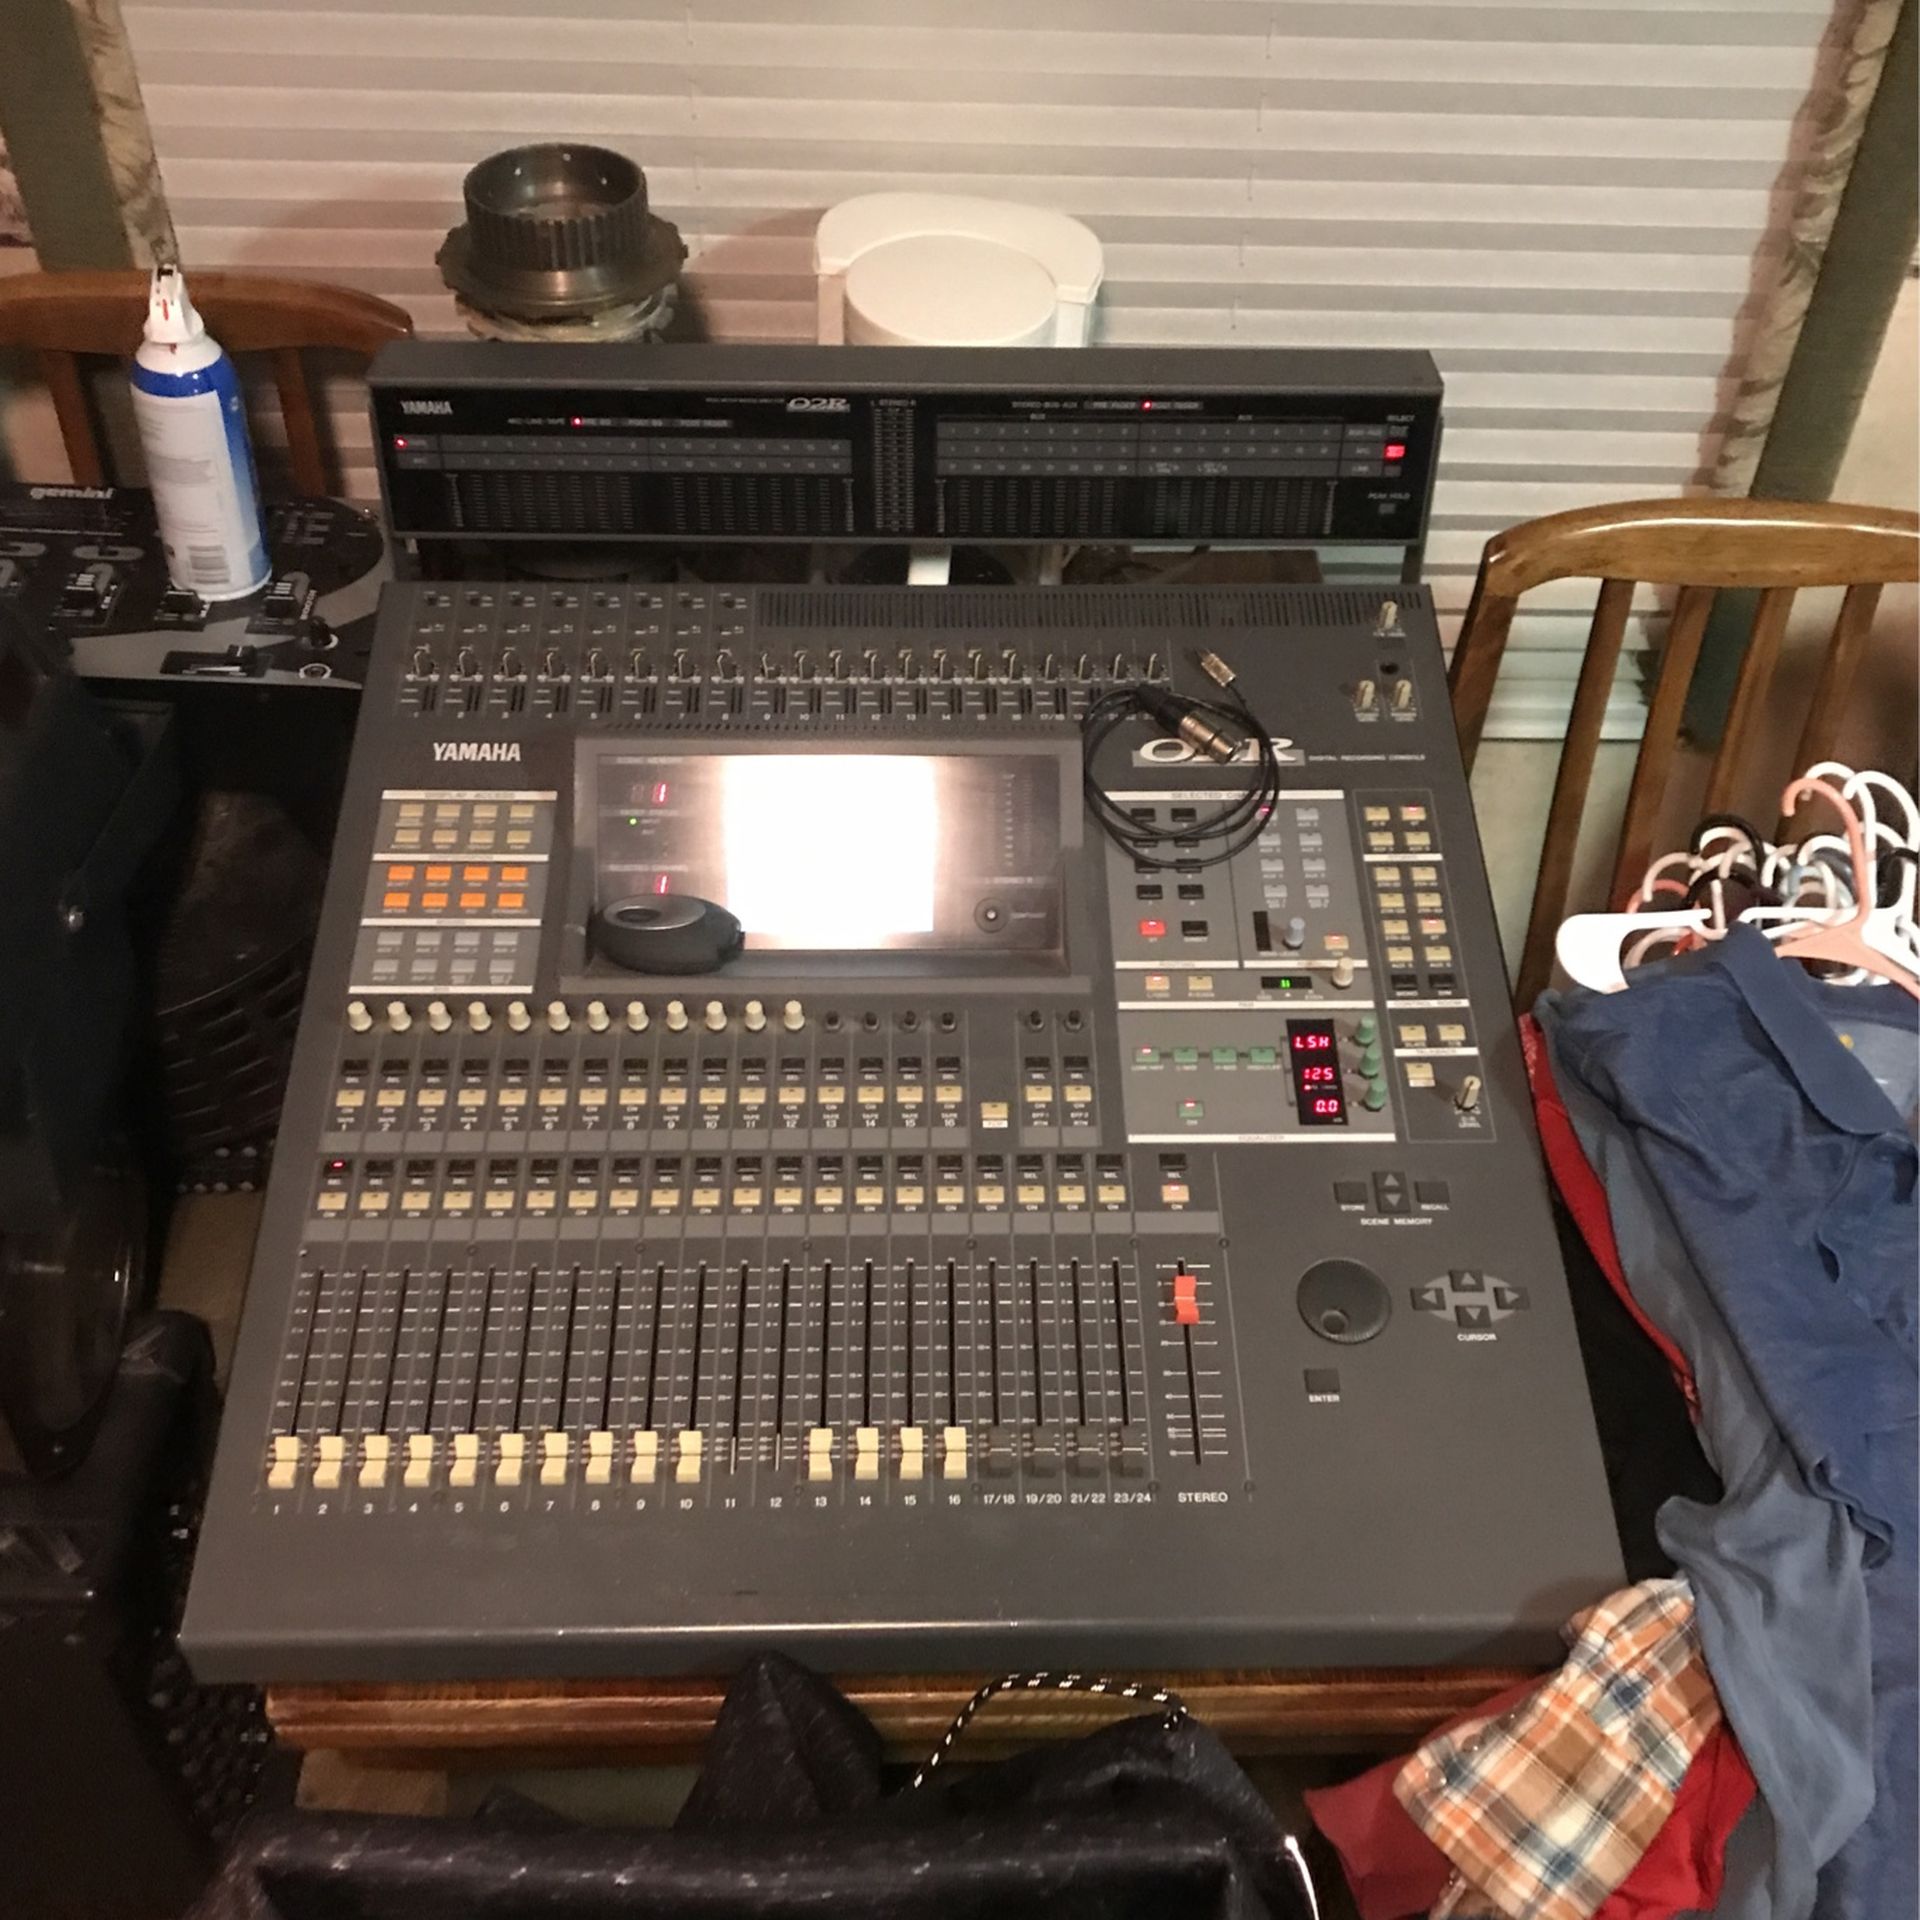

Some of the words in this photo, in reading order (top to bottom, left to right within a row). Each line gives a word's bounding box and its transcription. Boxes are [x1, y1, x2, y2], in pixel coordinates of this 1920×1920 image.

[401, 401, 453, 415] YAMAHA
[433, 742, 521, 761] YAMAHA
[1171, 792, 1222, 800] SELECTED
[341, 1123, 347, 1131] 1
[381, 1123, 391, 1131] 2
[423, 1123, 431, 1131] 3
[464, 1123, 471, 1131] 4
[504, 1122, 513, 1131] 5
[545, 1122, 553, 1131] 6
[586, 1122, 593, 1130] 7
[627, 1122, 635, 1130] 8
[668, 1121, 676, 1130] 9
[706, 1120, 717, 1129] 10
[746, 1120, 755, 1128] 11
[786, 1119, 797, 1128] 12
[826, 1119, 836, 1128] 13
[905, 1119, 915, 1128] 15
[945, 1118, 955, 1127] 16
[1457, 1333, 1497, 1341] CURSOR
[1309, 1394, 1340, 1402] ENTER
[1178, 1492, 1228, 1503] STEREO
[273, 1504, 280, 1515] 1
[317, 1503, 328, 1514] 2
[363, 1503, 374, 1514] 3
[408, 1502, 418, 1513] 4
[454, 1502, 464, 1513] 5
[500, 1501, 510, 1512] 6
[546, 1500, 555, 1511] 7
[591, 1499, 601, 1511] 8
[636, 1499, 646, 1510] 9
[680, 1498, 693, 1510] 10
[725, 1498, 736, 1508] 11
[770, 1497, 783, 1508] 12
[815, 1496, 828, 1508] 13
[860, 1496, 872, 1507] 14
[904, 1495, 917, 1506] 15
[949, 1495, 961, 1506] 16
[983, 1494, 1016, 1504] 17/18
[1026, 1494, 1062, 1504] 19/20
[1070, 1493, 1106, 1504] 21/22
[1114, 1493, 1151, 1503] 23/24
